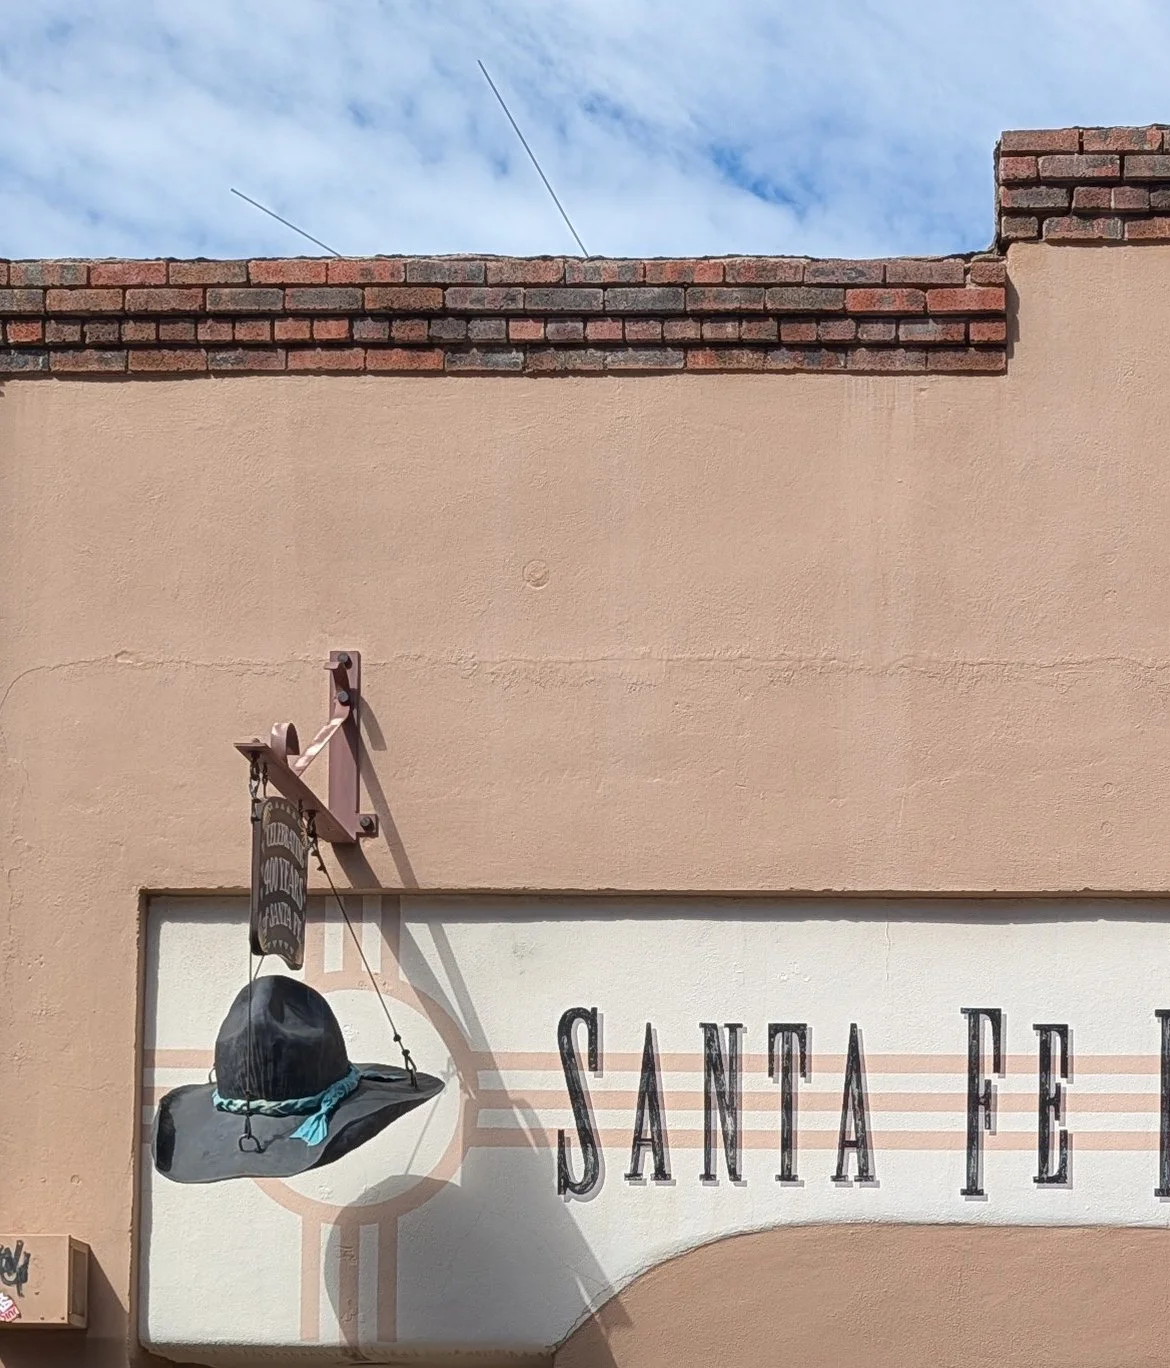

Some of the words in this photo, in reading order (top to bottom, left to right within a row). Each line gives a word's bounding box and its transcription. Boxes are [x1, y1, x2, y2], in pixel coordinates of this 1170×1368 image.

[263, 856, 278, 896] 400
[279, 857, 303, 911] YEARS
[269, 901, 292, 930] SANTA
[292, 911, 302, 945] FE
[557, 1006, 879, 1200] SANTA
[960, 1007, 1072, 1200] FE
